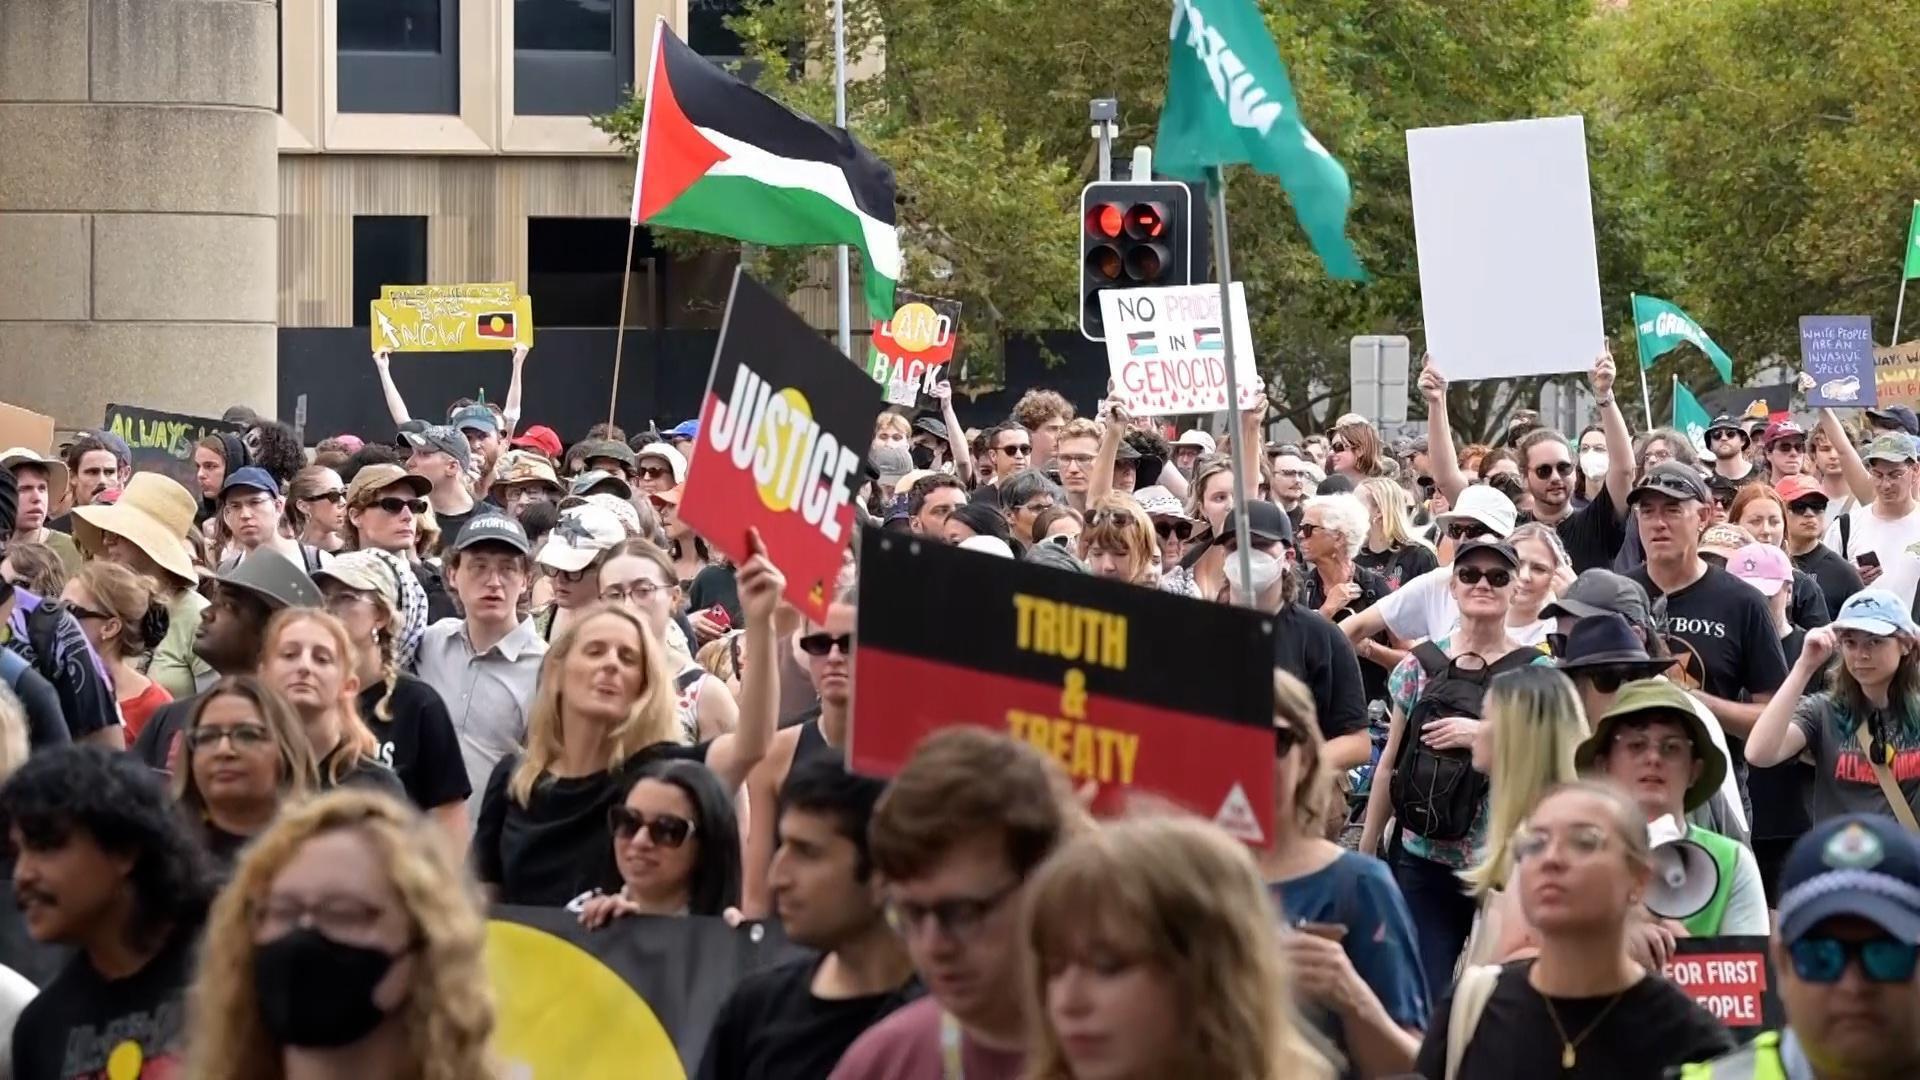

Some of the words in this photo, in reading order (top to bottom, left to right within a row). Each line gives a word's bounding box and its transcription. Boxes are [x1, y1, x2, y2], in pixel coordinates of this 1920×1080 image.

[881, 306, 951, 346] LAND
[1117, 297, 1155, 322] NO
[401, 321, 465, 345] NOW
[1169, 335, 1187, 351] IN
[1803, 327, 1833, 338] WHITE
[1838, 327, 1869, 340] PEOPLE
[873, 352, 942, 394] BACK
[1122, 357, 1226, 393] GENOCID
[110, 413, 193, 459] ALWAYS
[709, 361, 860, 543] JUSTICE
[1012, 592, 1128, 671] TRUTH
[1669, 616, 1726, 638] BOYS
[1060, 667, 1088, 720] &
[1005, 708, 1140, 785] TREATY
[1662, 961, 1704, 986] FOR
[1706, 960, 1758, 985] FIRST
[1696, 995, 1755, 1018] OPLE
